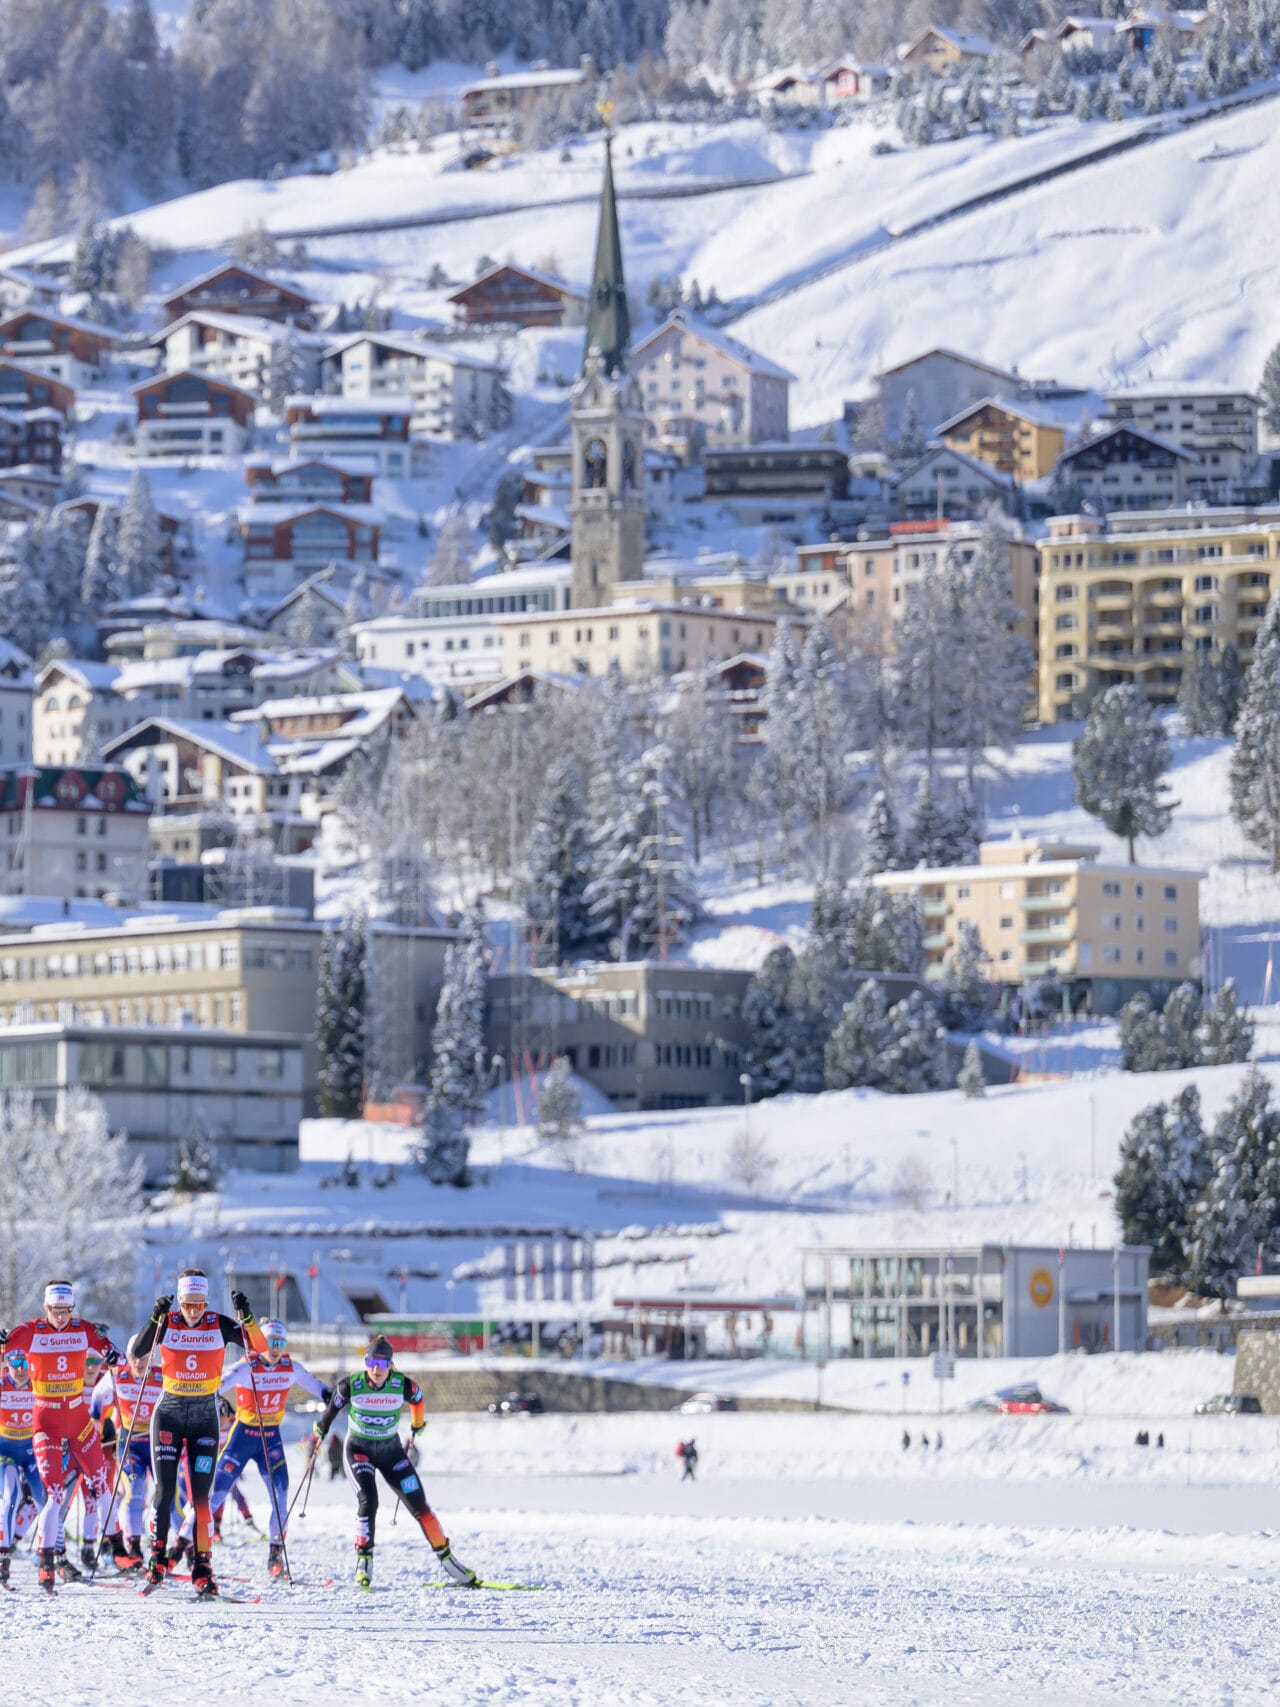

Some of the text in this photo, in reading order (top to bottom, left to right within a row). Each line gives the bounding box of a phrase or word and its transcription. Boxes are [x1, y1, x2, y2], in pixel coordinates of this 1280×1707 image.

[50, 1336, 81, 1345] Sunrise
[181, 1335, 214, 1343] Sunrise
[57, 1355, 68, 1372] 8
[186, 1354, 197, 1371] 6
[47, 1372, 76, 1380] ENGADIN
[176, 1371, 207, 1380] ENGADIN
[262, 1376, 290, 1384] Sunrise
[10, 1395, 33, 1403] Sunri
[262, 1393, 281, 1407] 14
[366, 1396, 398, 1404] Sunrise
[11, 1412, 32, 1423] 10
[355, 1412, 395, 1425] coop
